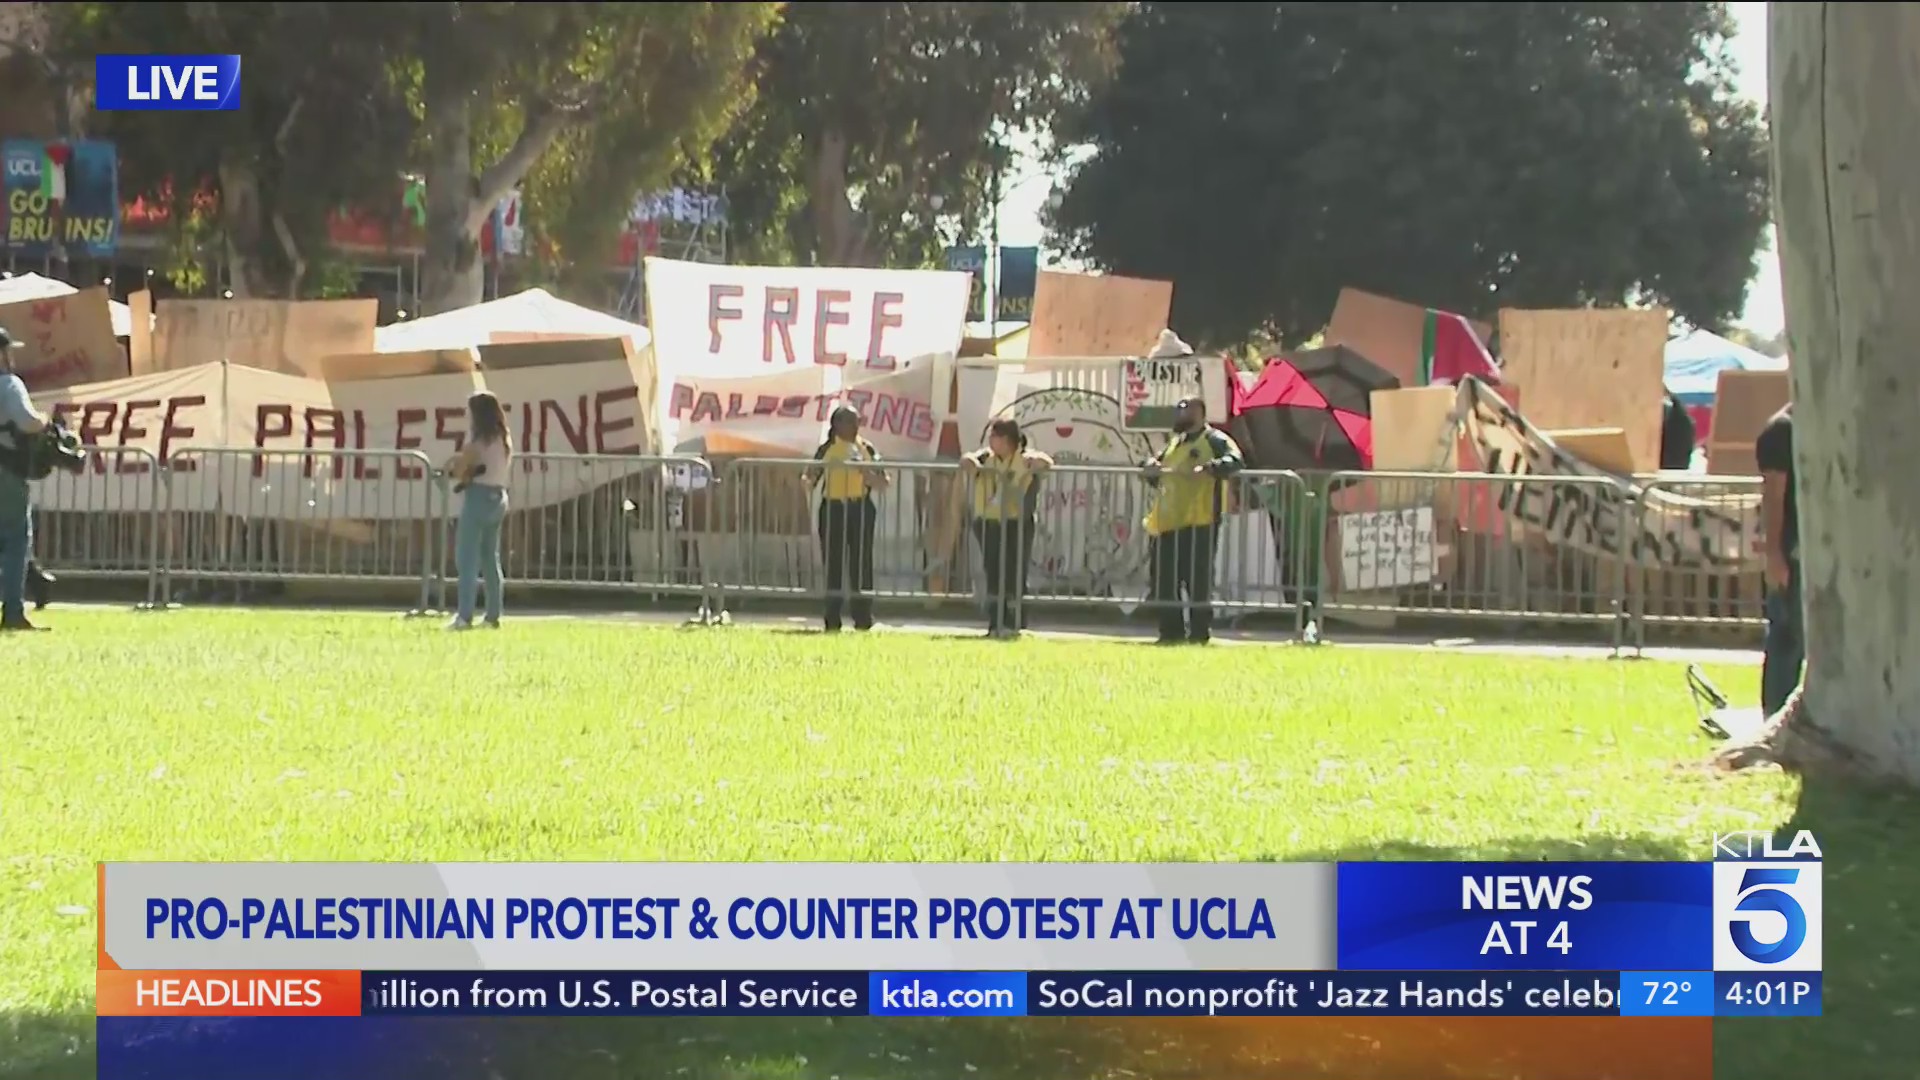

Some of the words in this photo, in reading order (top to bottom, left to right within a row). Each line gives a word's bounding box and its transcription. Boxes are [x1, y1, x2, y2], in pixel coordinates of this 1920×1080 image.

[8, 160, 46, 175] UCL
[10, 189, 48, 214] GO
[708, 284, 905, 370] FREE
[252, 385, 640, 479] PALESINE
[669, 382, 935, 442] PALESTINE
